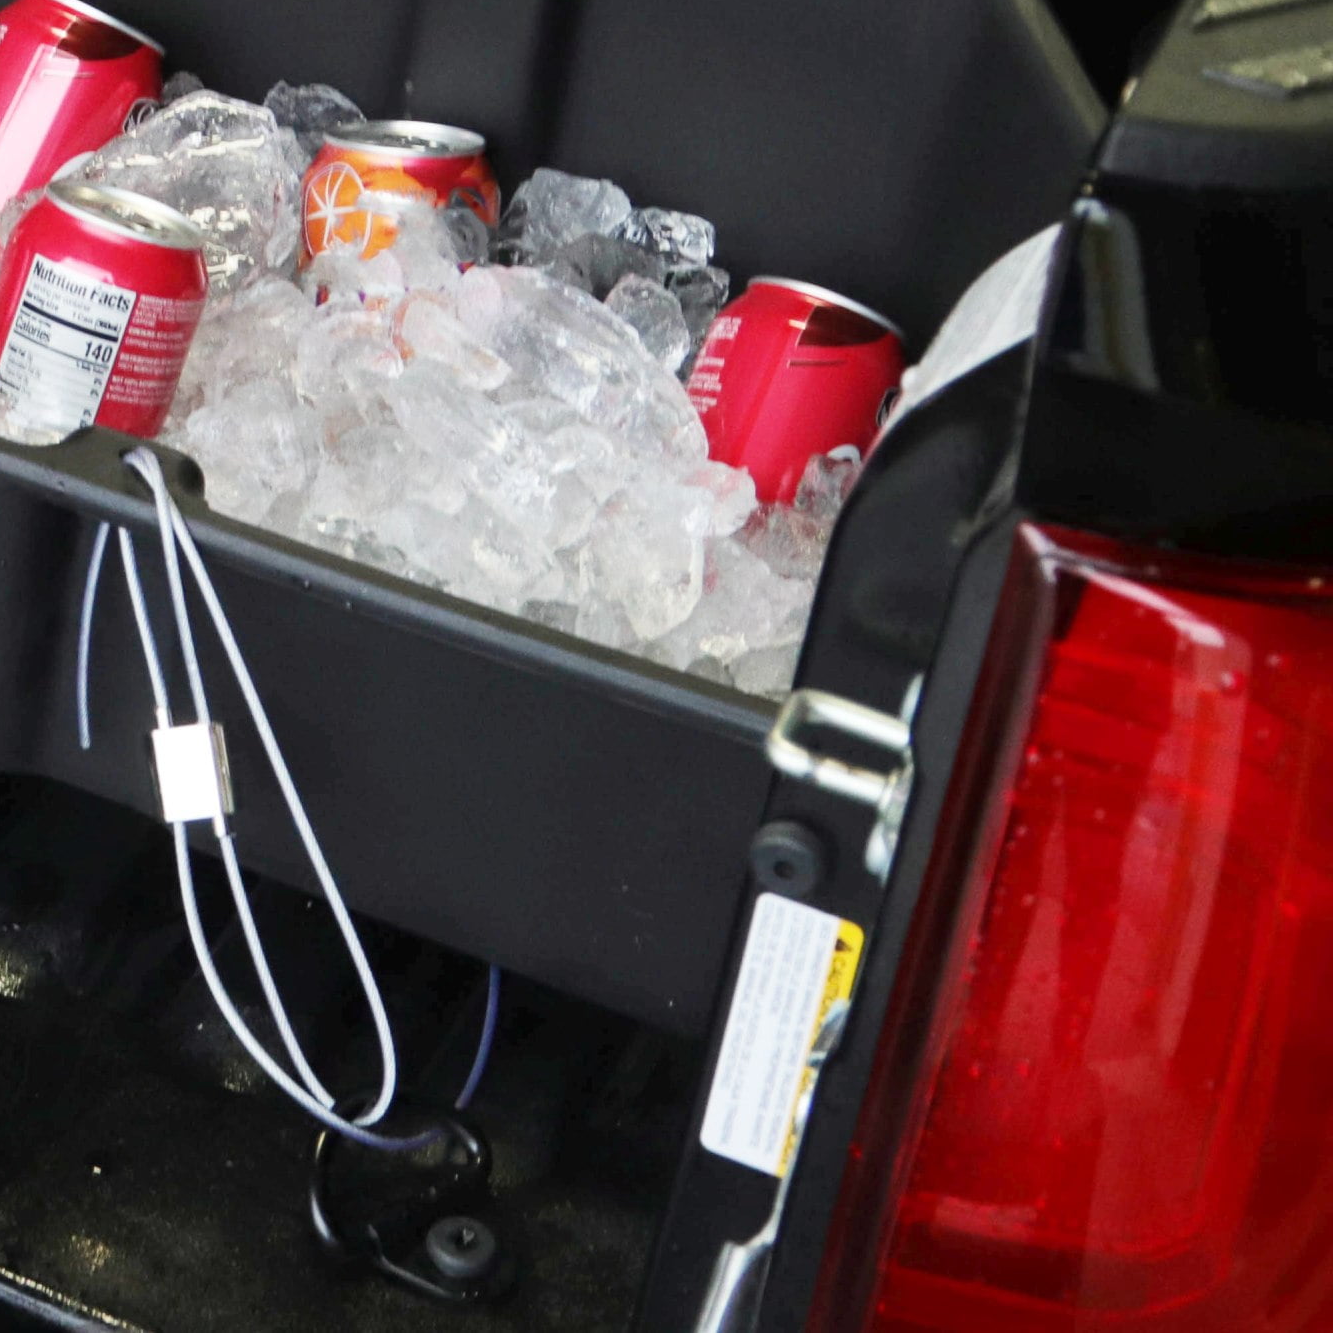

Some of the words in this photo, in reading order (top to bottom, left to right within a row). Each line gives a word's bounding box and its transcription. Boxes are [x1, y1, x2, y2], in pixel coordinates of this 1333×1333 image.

[34, 260, 88, 297] Nutrition
[90, 288, 130, 314] Facts
[15, 316, 51, 343] Calories
[85, 341, 113, 364] 140
